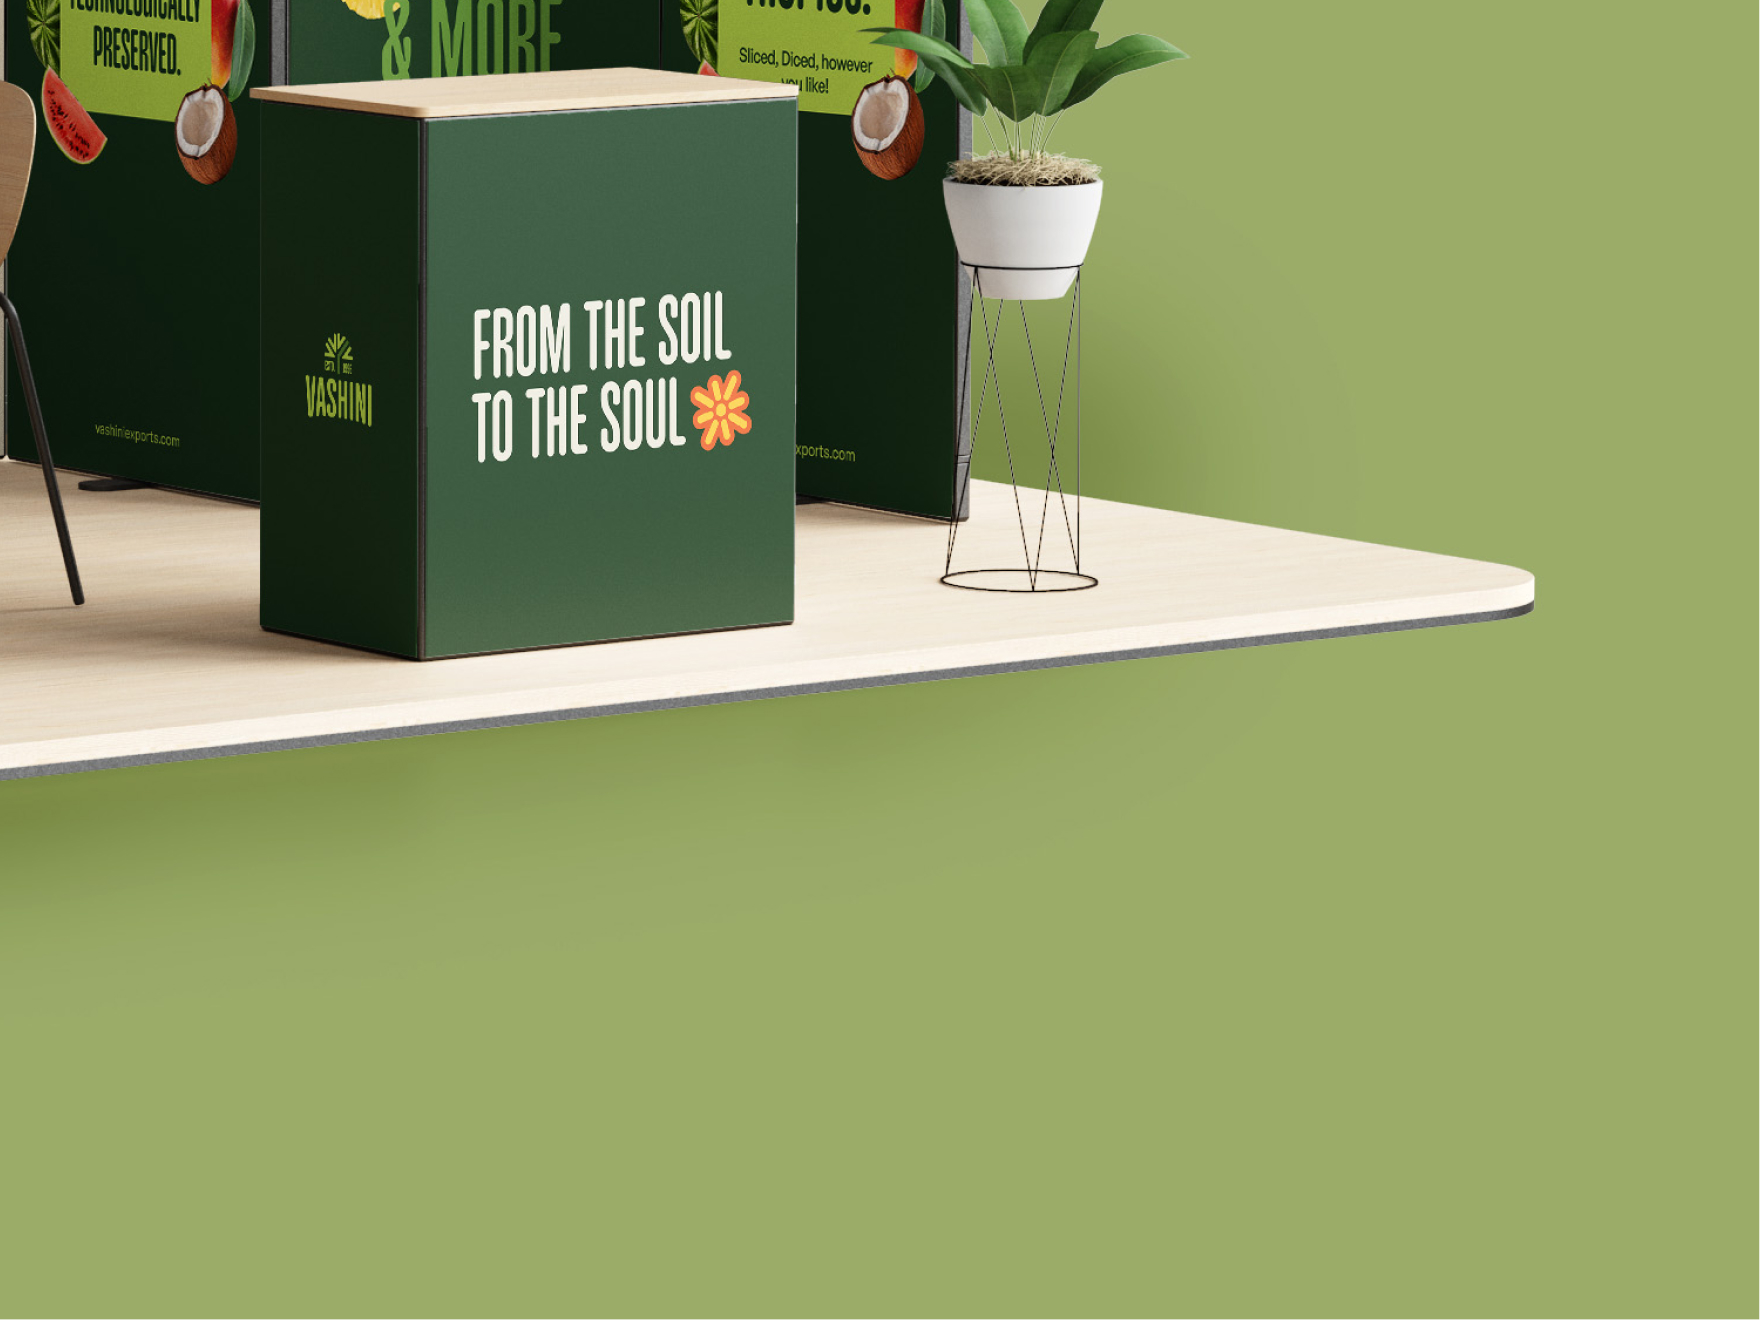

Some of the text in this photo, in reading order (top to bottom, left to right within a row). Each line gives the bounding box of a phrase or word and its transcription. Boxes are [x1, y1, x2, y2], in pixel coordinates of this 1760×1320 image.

[93, 25, 181, 76] PRESERVED.
[739, 46, 873, 73] Sliced, Diced, however
[805, 76, 829, 94] like!
[474, 291, 732, 380] FROM THE SOIL
[305, 374, 372, 428] VASHINI
[472, 377, 687, 463] TO THE SOUL
[95, 424, 180, 447] vashiniexports.com
[796, 444, 856, 462] xports.com
